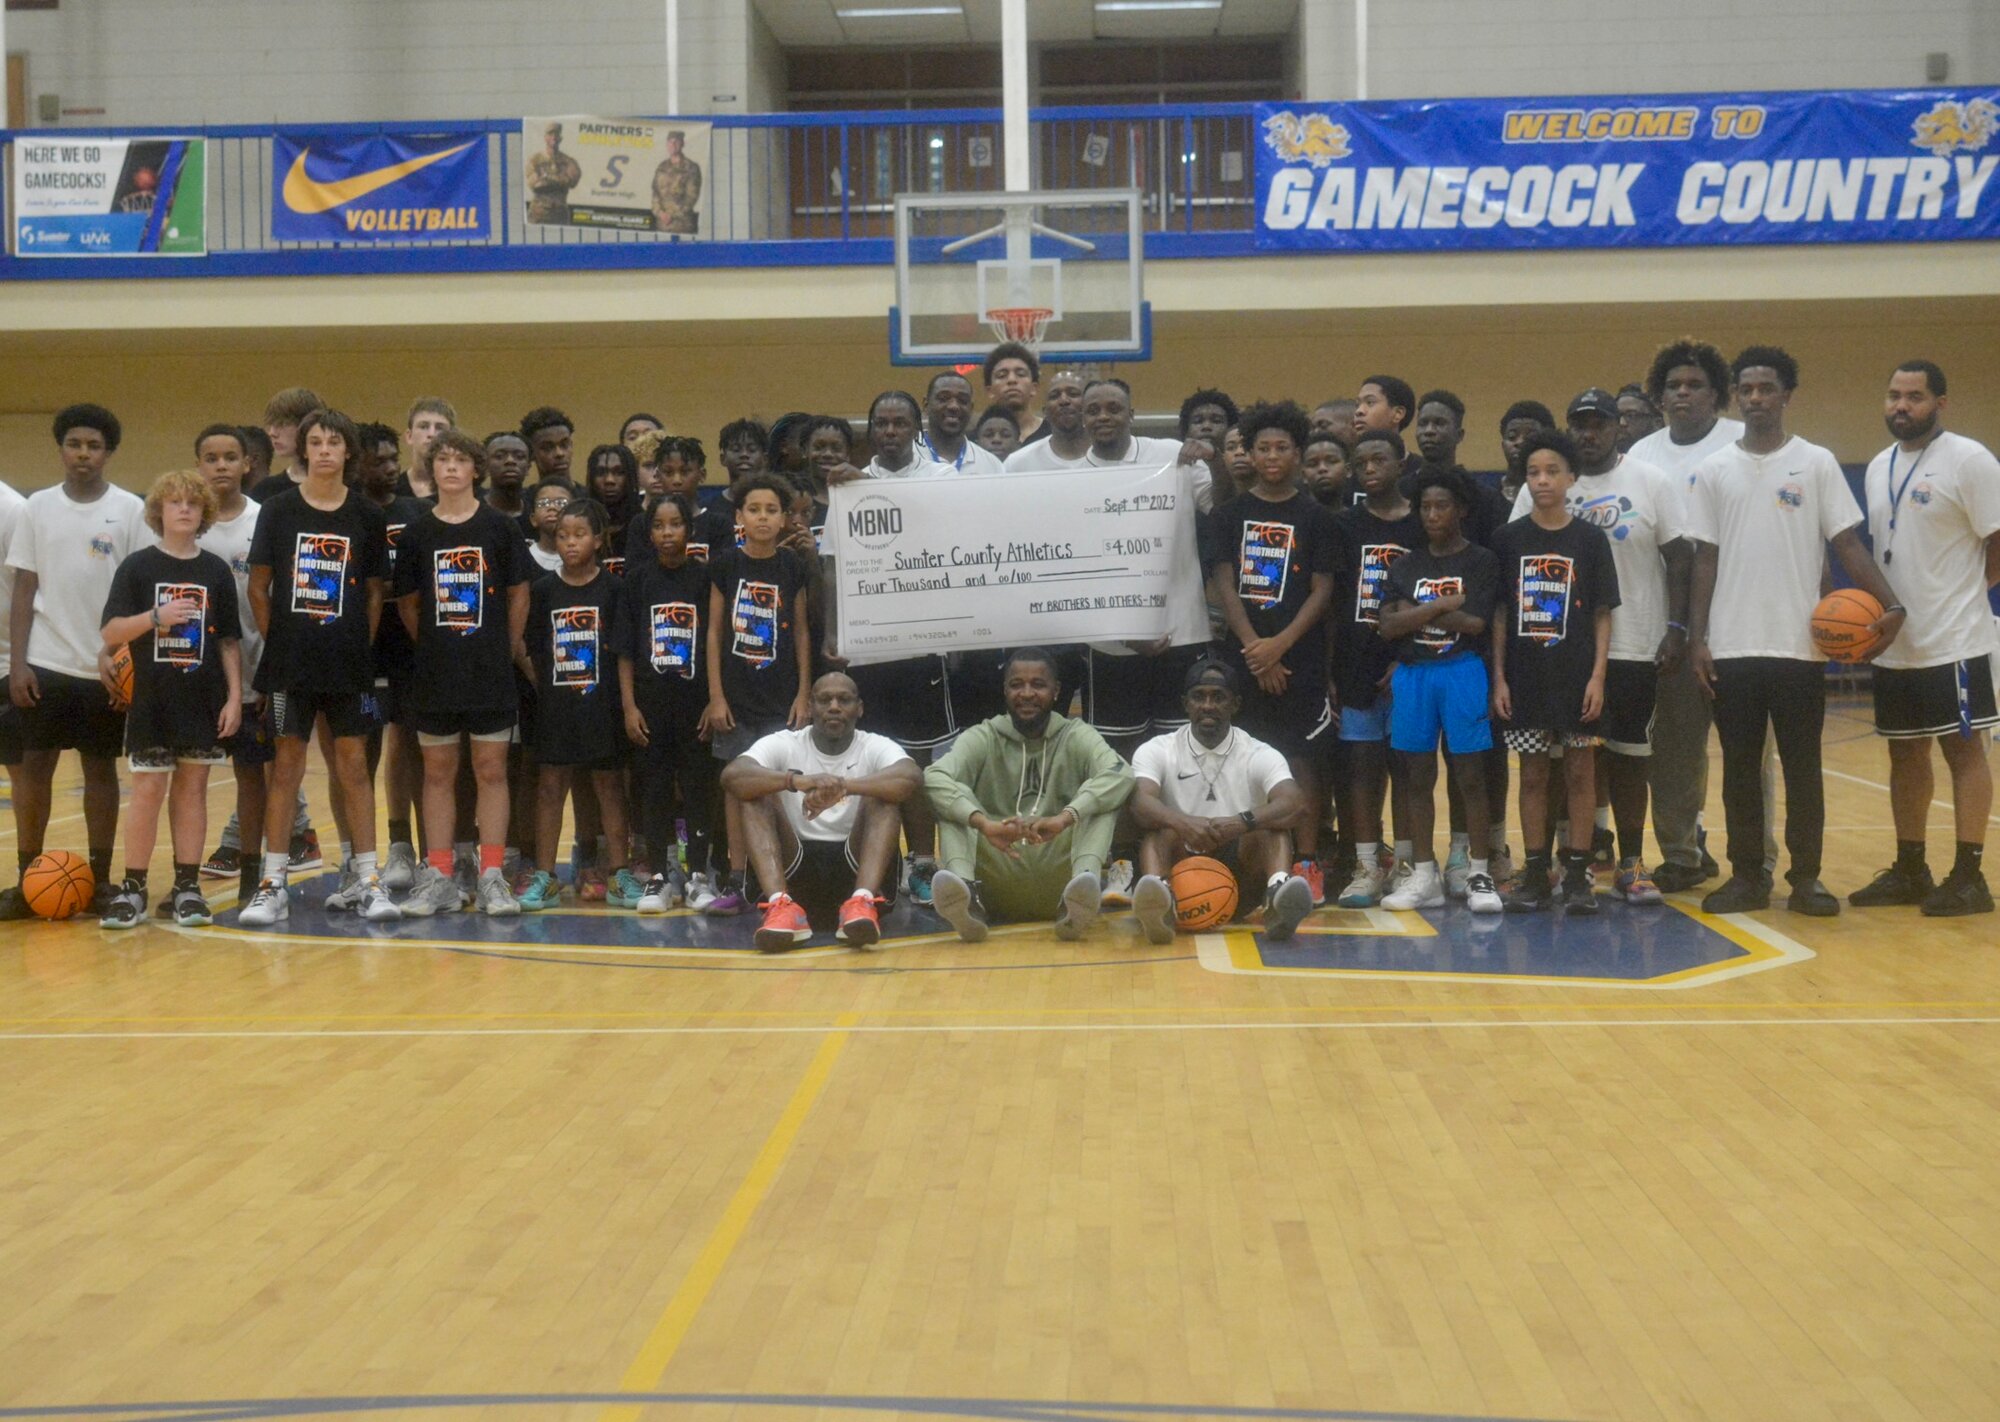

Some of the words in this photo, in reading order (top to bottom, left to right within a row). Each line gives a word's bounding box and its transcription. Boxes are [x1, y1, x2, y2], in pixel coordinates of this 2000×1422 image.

[578, 123, 642, 136] PARTNERS
[1502, 108, 1699, 143] WELCOME
[1711, 106, 1767, 140] TO
[24, 146, 57, 163] HERE
[61, 146, 80, 163] WE
[83, 146, 101, 163] GO
[600, 154, 630, 188] S
[24, 172, 107, 189] GAMECOCKS!
[1263, 163, 1647, 230] GAMECOCK
[1675, 155, 2000, 225] COUNTRY
[345, 207, 478, 231] VOLLEYBALL
[1104, 498, 1129, 516] Sept
[1149, 494, 1176, 511] 2023
[847, 507, 903, 538] MBNO
[1246, 531, 1260, 541] MY
[300, 543, 315, 554] MY
[1246, 546, 1286, 558] BROTHERS
[894, 548, 945, 571] Sumter
[951, 544, 1002, 571] County
[1007, 542, 1073, 562] Athletics
[1365, 555, 1378, 565] MY
[299, 558, 342, 572] BROTHERS
[438, 559, 451, 569] MY
[846, 560, 858, 568] PAY
[870, 558, 883, 566] THE
[1244, 560, 1255, 570] NO
[846, 568, 870, 576] ORDER
[871, 566, 881, 574] OF
[1524, 566, 1538, 576] MY
[298, 573, 310, 583] NO
[438, 572, 480, 584] BROTHERS
[858, 580, 888, 595] Four
[888, 572, 950, 592] Thousand
[965, 573, 987, 587] and
[1242, 575, 1270, 586] OTHERS
[438, 588, 449, 598] NO
[1362, 585, 1374, 594] NO
[1419, 586, 1432, 595] MY
[1524, 582, 1566, 593] BROTHERS
[297, 588, 329, 600] OTHERS
[741, 589, 753, 599] MY
[440, 602, 469, 612] OTHERS
[1029, 601, 1043, 614] MY
[1046, 597, 1091, 612] BROTHERS
[1095, 596, 1107, 609] NO
[1524, 597, 1533, 607] NO
[555, 618, 567, 628] MY
[655, 614, 666, 624] MY
[736, 617, 748, 628] NO
[556, 630, 595, 643] BROTHERS
[656, 628, 692, 639] BROTHERS
[158, 638, 192, 648] OTHERS
[656, 642, 665, 652] NO
[556, 646, 567, 657] NO
[654, 655, 683, 665] OTHERS
[556, 660, 586, 672] OTHERS
